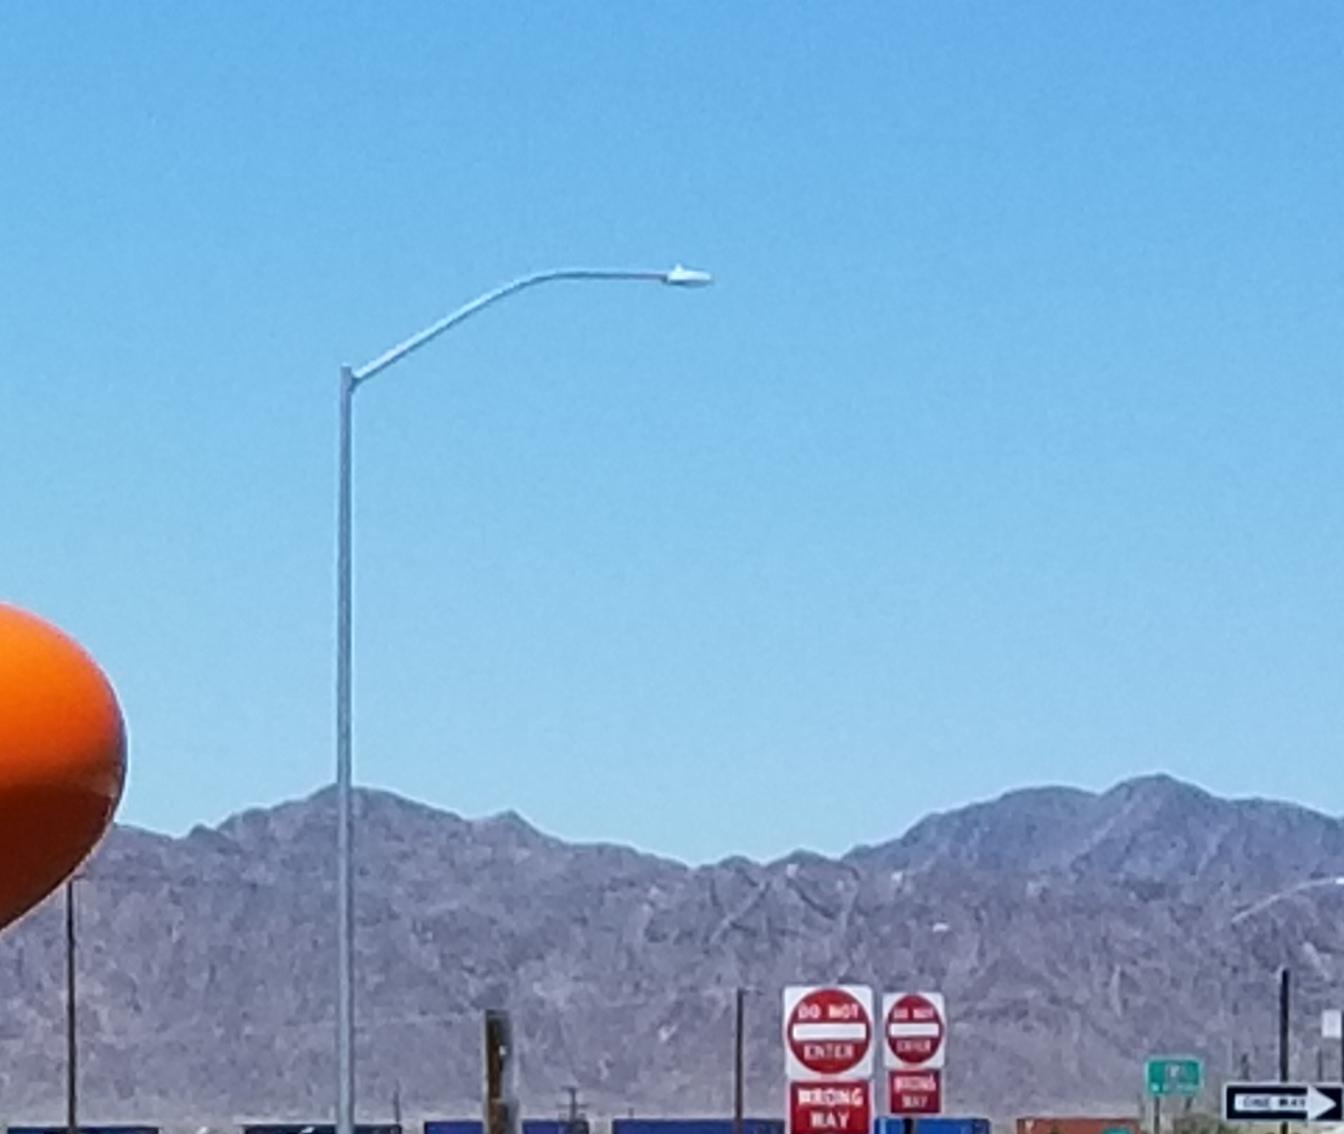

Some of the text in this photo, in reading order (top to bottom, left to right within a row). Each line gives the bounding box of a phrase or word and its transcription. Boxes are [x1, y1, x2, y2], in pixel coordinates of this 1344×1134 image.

[798, 1003, 858, 1019] DO NOT
[803, 1044, 854, 1061] ENTER
[798, 1088, 863, 1105] WRONG
[812, 1110, 849, 1128] WAY
